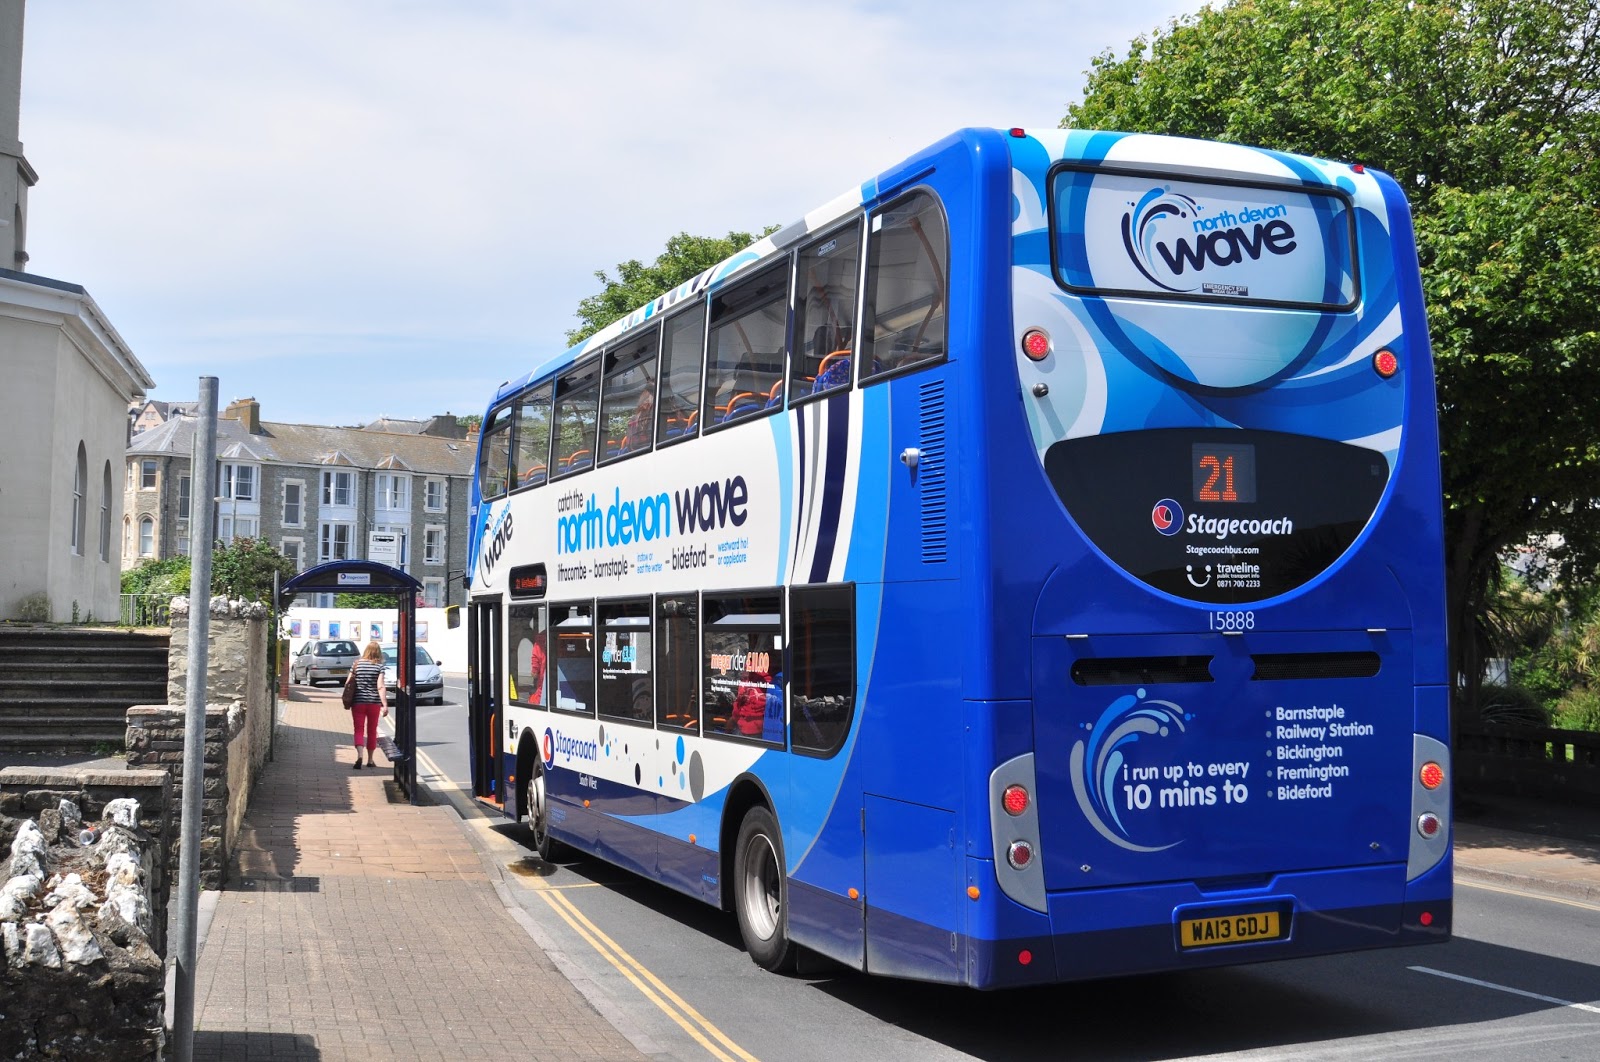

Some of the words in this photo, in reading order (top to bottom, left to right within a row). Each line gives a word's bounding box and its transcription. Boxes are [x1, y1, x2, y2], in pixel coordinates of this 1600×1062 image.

[1193, 210, 1237, 233] north
[1238, 204, 1287, 224] devon
[1156, 219, 1297, 276] wave
[1199, 455, 1237, 501] 21
[557, 489, 573, 513] catch
[573, 487, 584, 509] the
[557, 492, 603, 555] north
[606, 486, 670, 547] devon
[675, 475, 748, 536] wave
[1186, 513, 1293, 540] Stagecoach
[484, 512, 514, 575] wave
[1186, 544, 1260, 557] Stagecoachbus.com
[557, 561, 587, 582] ilfracombe
[594, 553, 628, 581] barnstaple
[672, 543, 707, 571] bideford
[1216, 561, 1260, 574] traveline
[1216, 580, 1232, 588] 0871
[1233, 580, 1245, 588] 700
[1246, 580, 1261, 588] 2233
[1209, 611, 1256, 631] 15888
[1276, 704, 1345, 722] Barnstaple
[1276, 724, 1327, 741] Railway
[1329, 721, 1374, 737] Station
[555, 729, 598, 763] Stagecoach
[1276, 744, 1343, 762] Bickington
[578, 772, 589, 788] South
[588, 775, 598, 790] West
[1123, 763, 1129, 781] i
[1132, 766, 1159, 781] run
[1163, 765, 1184, 783] up
[1187, 761, 1204, 778] to
[1207, 761, 1250, 779] every
[1277, 763, 1349, 781] Fremington
[1123, 783, 1152, 811] 10
[1159, 779, 1218, 809] mins
[1222, 779, 1249, 804] to
[1277, 782, 1332, 800] Bideford
[1192, 918, 1232, 942] WA13
[1235, 914, 1270, 938] GDJ
